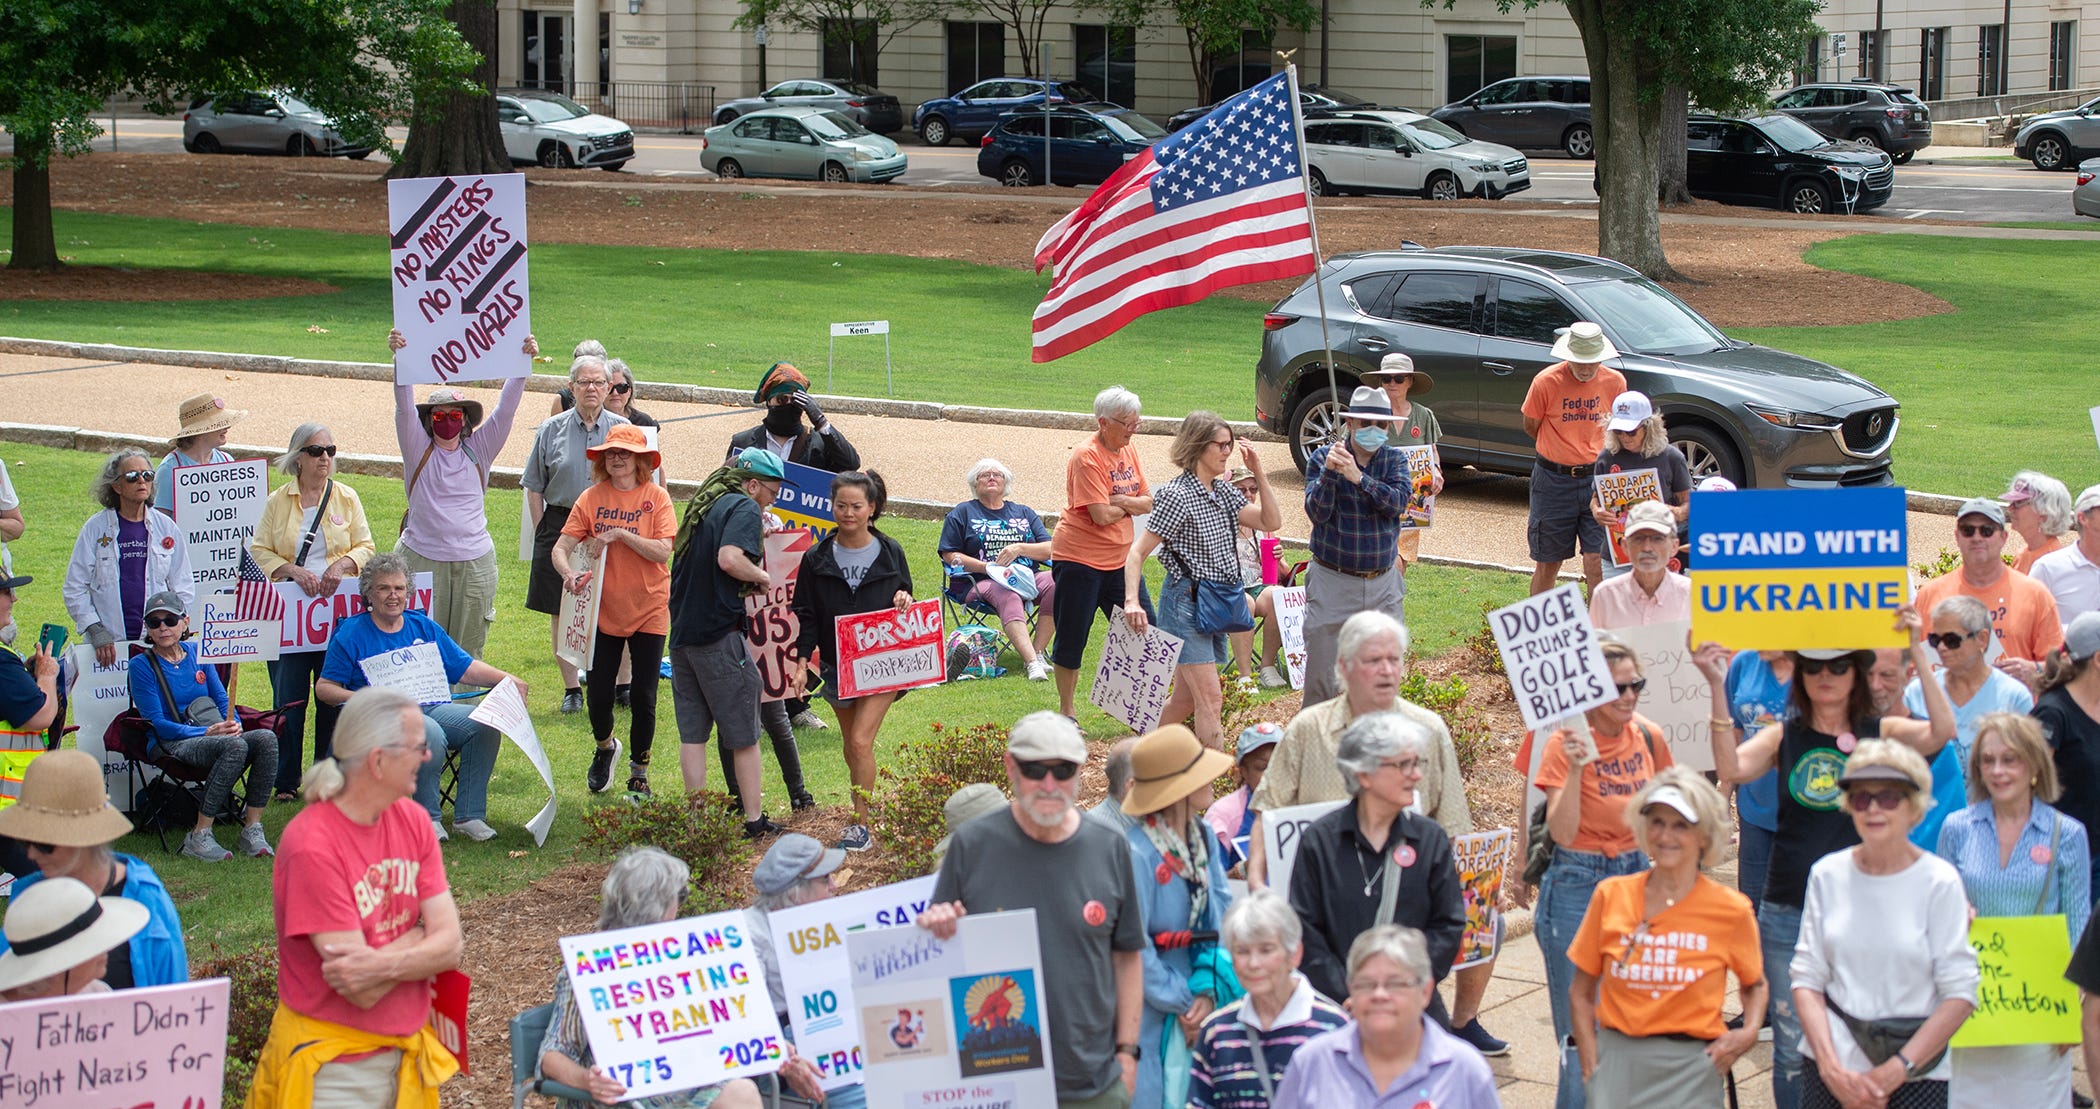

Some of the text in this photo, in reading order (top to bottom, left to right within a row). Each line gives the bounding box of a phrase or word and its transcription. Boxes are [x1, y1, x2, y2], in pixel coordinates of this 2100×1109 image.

[394, 178, 494, 288] NO MASTERS
[418, 216, 511, 324] NO KINGS
[431, 279, 524, 382] NO NAZIS
[849, 327, 869, 335] Keen
[1563, 396, 1600, 410] Fed up?
[1562, 412, 1586, 422] Show
[180, 466, 259, 487] CONGRESS,
[1600, 473, 1654, 490] SOLIDARITY
[190, 486, 256, 504] DO YOUR
[1602, 485, 1658, 504] FOREVER
[206, 507, 237, 522] JOB!
[596, 506, 642, 523] Fed up?
[189, 525, 254, 544] MAINTAIN
[1697, 529, 1900, 557] STAND WITH
[210, 547, 236, 561] THE
[1700, 581, 1900, 613] UKRAINE
[1500, 590, 1575, 641] DOGE
[203, 622, 258, 639] Reverse
[853, 621, 899, 652] FOR
[202, 639, 256, 656] Reclaim
[1158, 640, 1179, 665] You
[1510, 623, 1588, 664] TRUMP'S
[391, 648, 418, 666] CWA
[1521, 645, 1590, 694] GOLF
[1130, 676, 1142, 700] you
[1530, 675, 1604, 719] BILLS
[1594, 758, 1621, 777] Fed
[1599, 780, 1632, 797] Show
[576, 925, 743, 976] AMERICANS
[788, 922, 842, 955] USA
[1641, 947, 1678, 965] ARE
[589, 962, 749, 1012] RESISTING
[802, 989, 838, 1020] NO
[36, 1010, 115, 1050] Father
[133, 996, 215, 1037] Didn't
[608, 994, 746, 1041] TYRANNY
[608, 1036, 781, 1088] 1775 2025
[0, 1043, 214, 1107] Fight Nazis for
[922, 1087, 967, 1104] STOP
